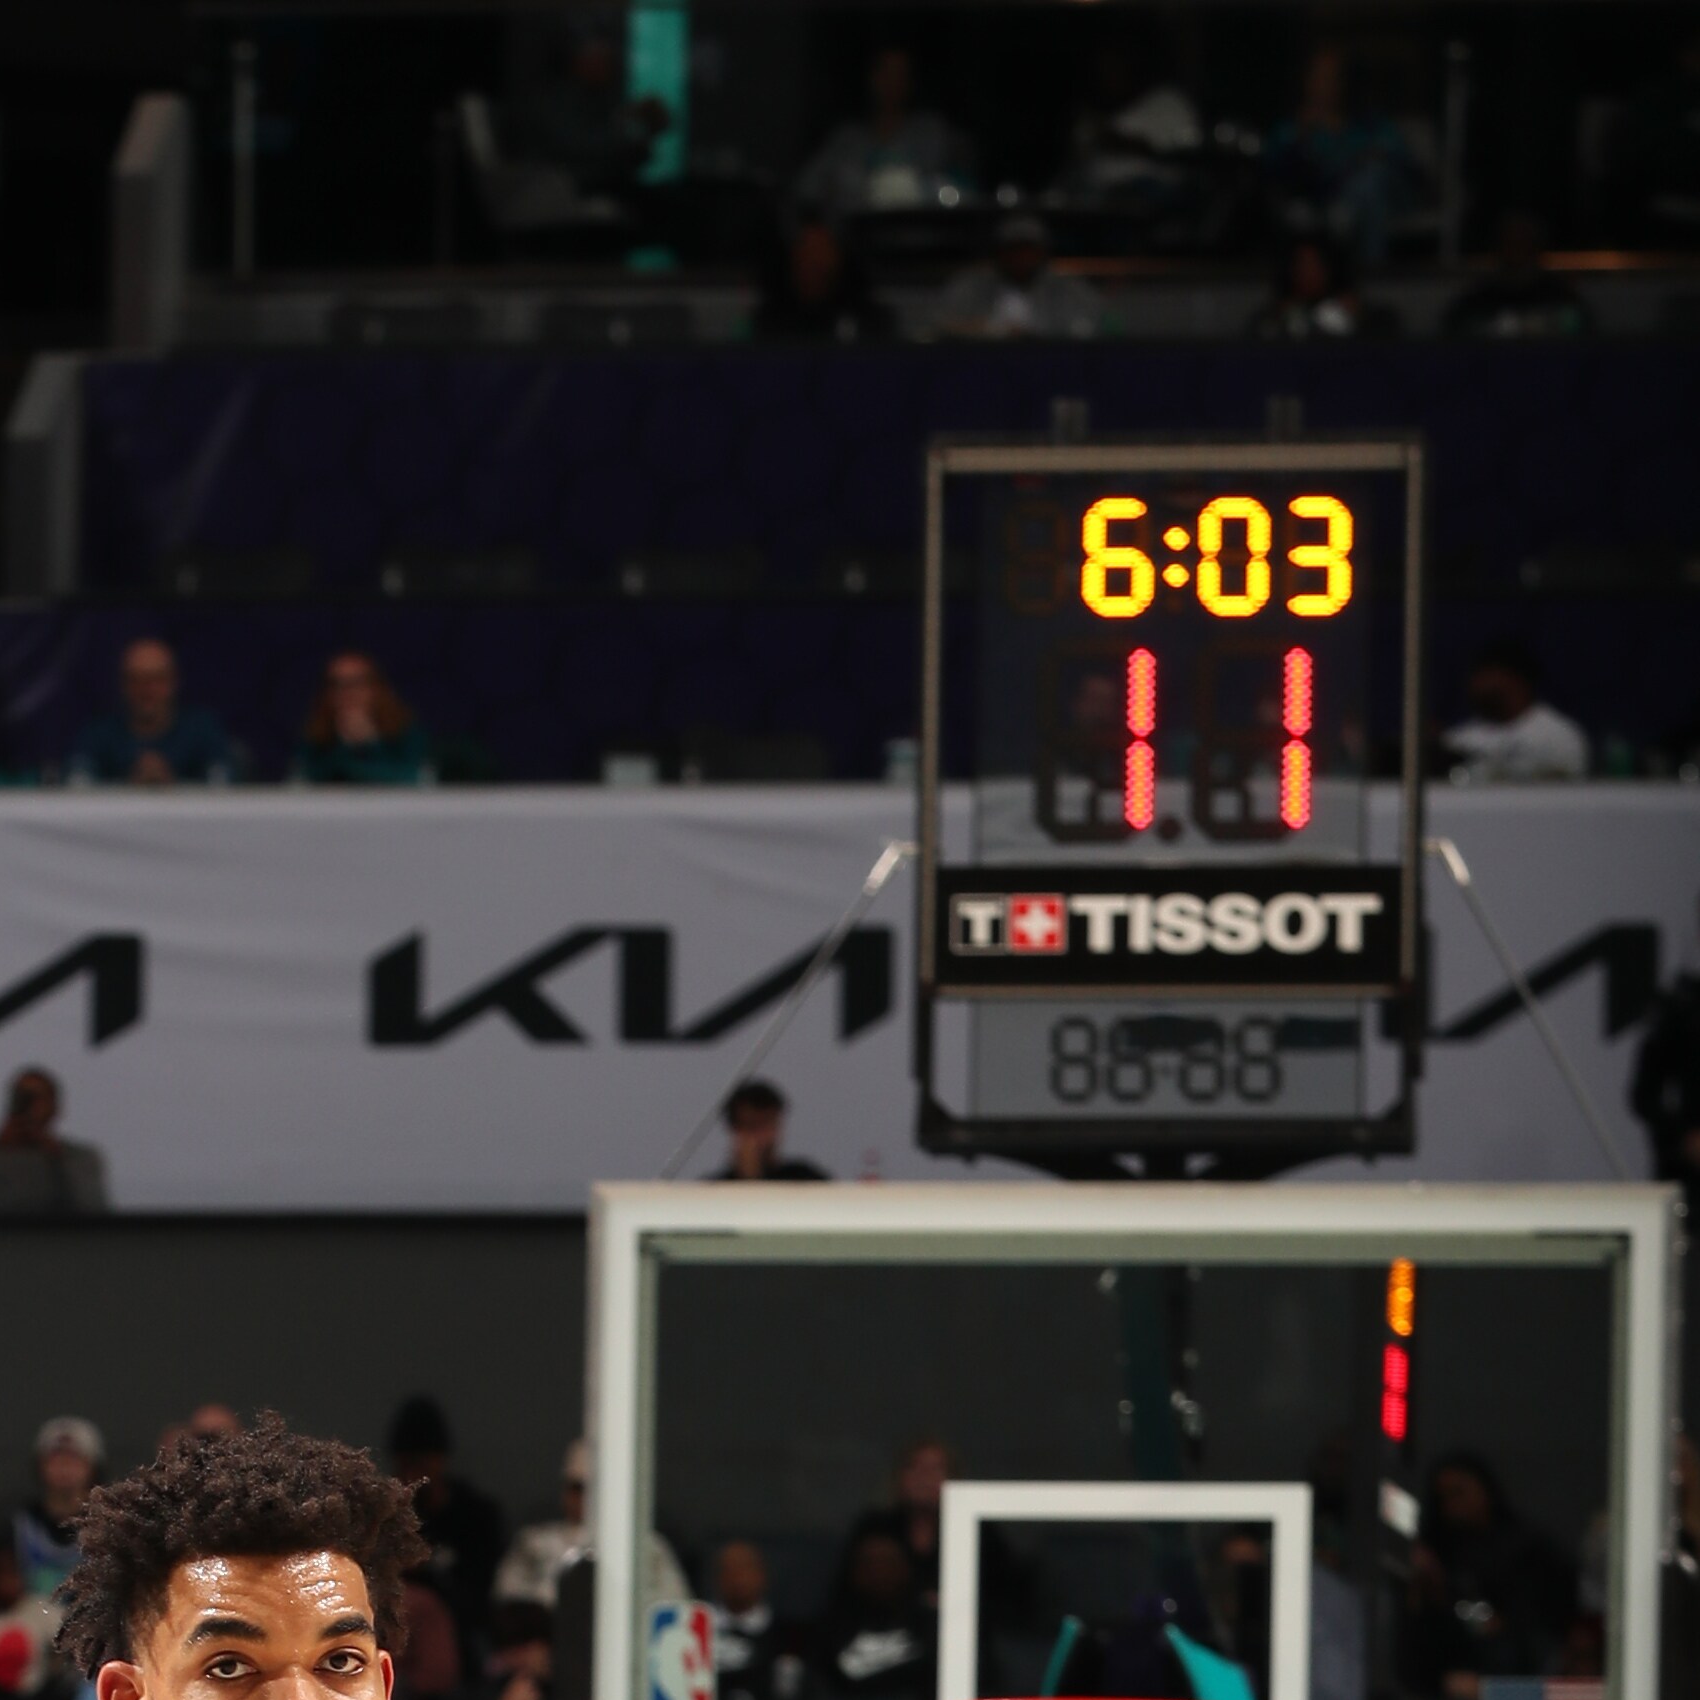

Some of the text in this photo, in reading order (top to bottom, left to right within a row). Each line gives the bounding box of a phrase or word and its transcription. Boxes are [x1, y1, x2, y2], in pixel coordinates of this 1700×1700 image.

[1080, 496, 1353, 618] 6:03
[1124, 647, 1313, 830] 11
[1071, 893, 1382, 954] TISSOT
[369, 924, 892, 1046] KIA
